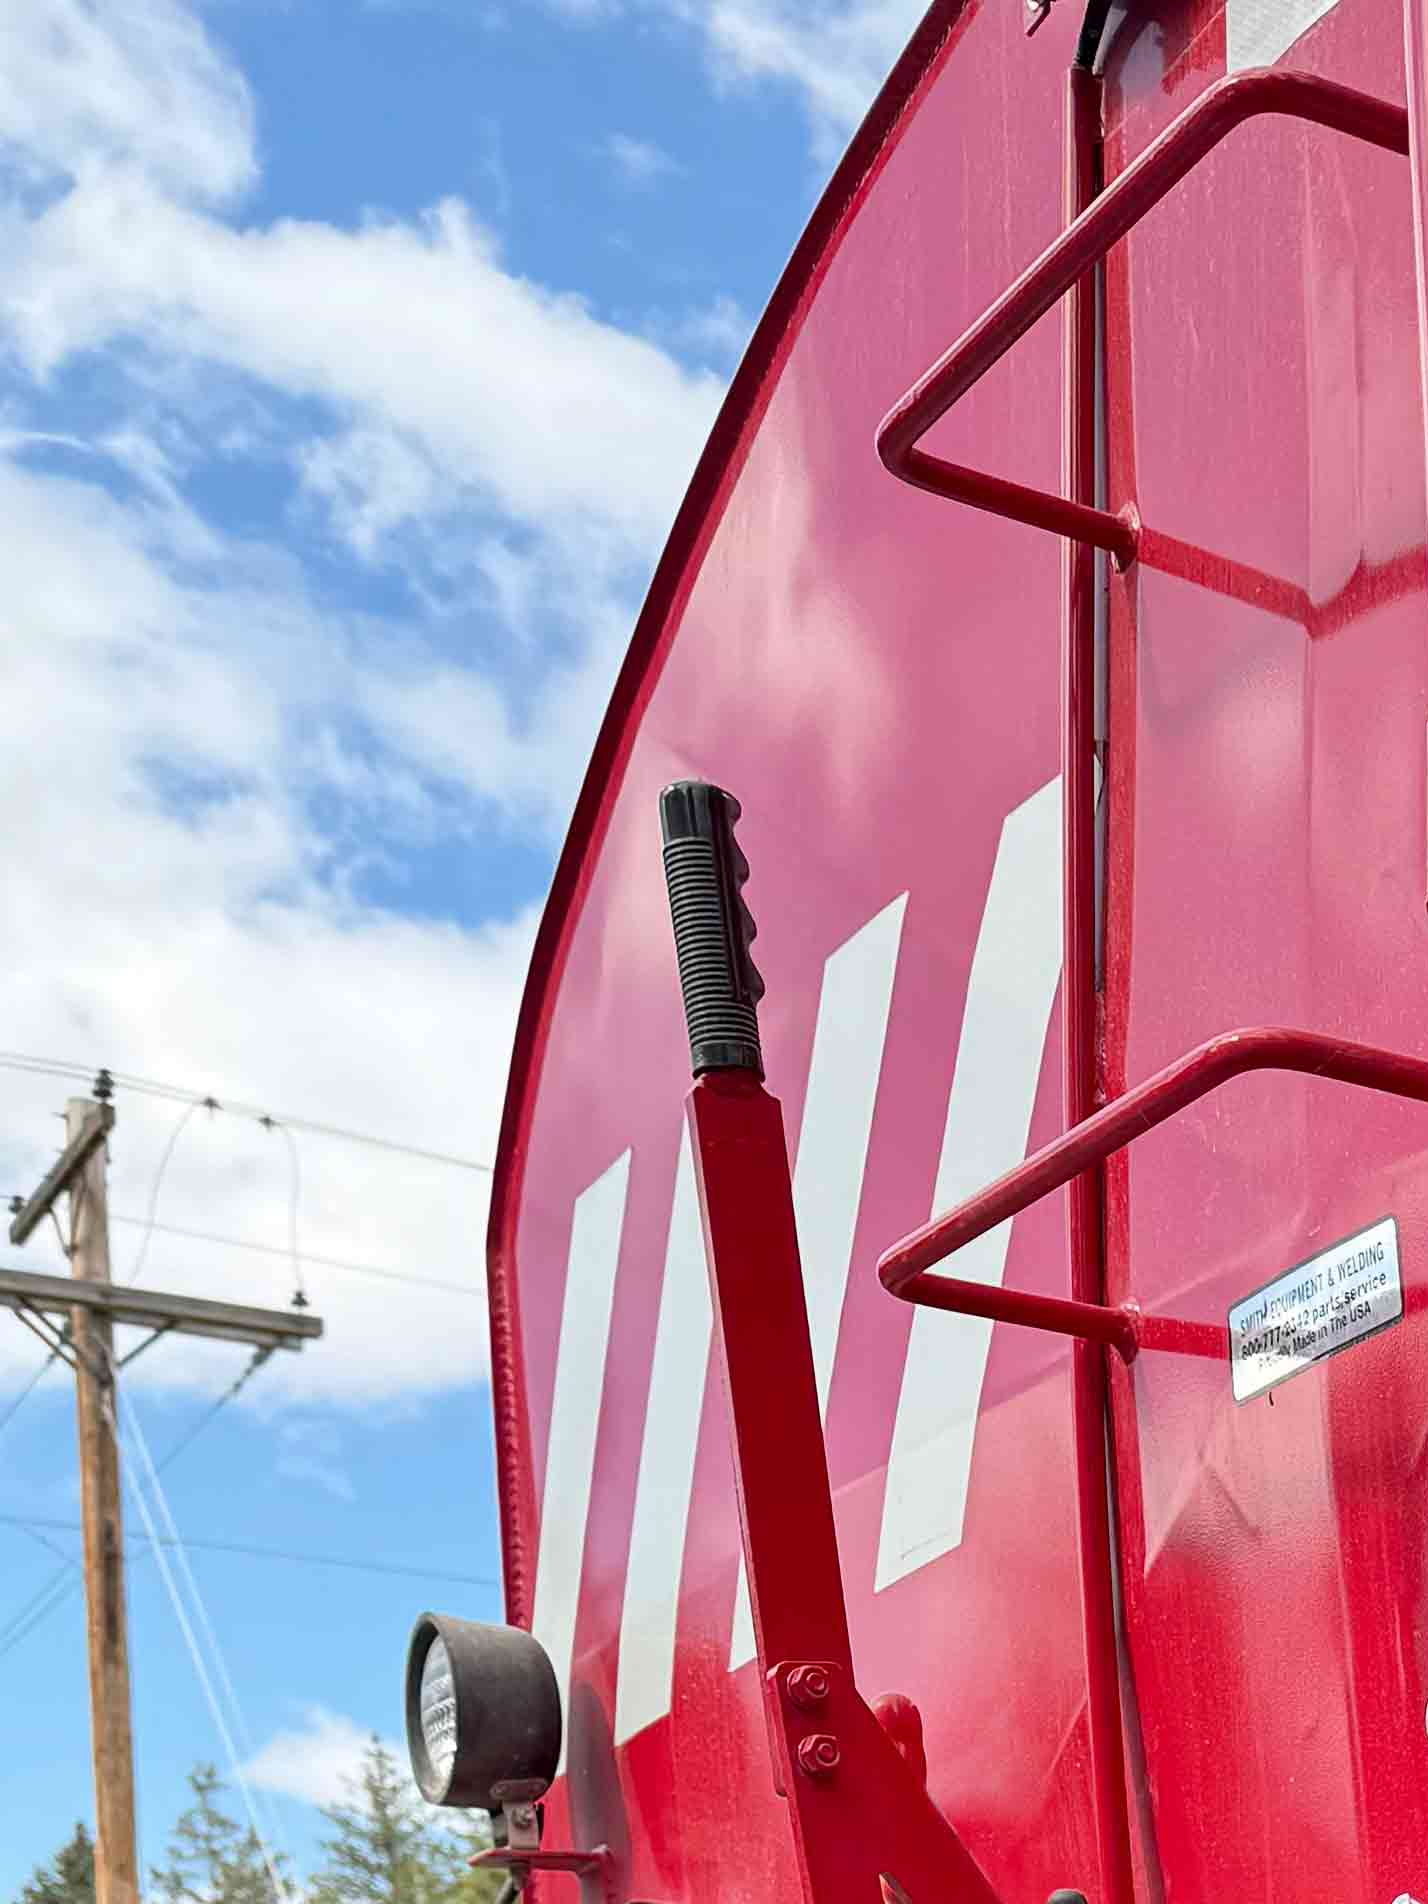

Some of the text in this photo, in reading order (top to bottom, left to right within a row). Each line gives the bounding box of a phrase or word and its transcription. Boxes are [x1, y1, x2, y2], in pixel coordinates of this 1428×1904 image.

[1271, 1274, 1323, 1319] EQUIPMENT
[1328, 1267, 1335, 1287] &
[1337, 1242, 1384, 1281] WELDING
[1292, 1329, 1316, 1353] Made
[1330, 1315, 1347, 1333] The
[1350, 1300, 1372, 1323] USA
